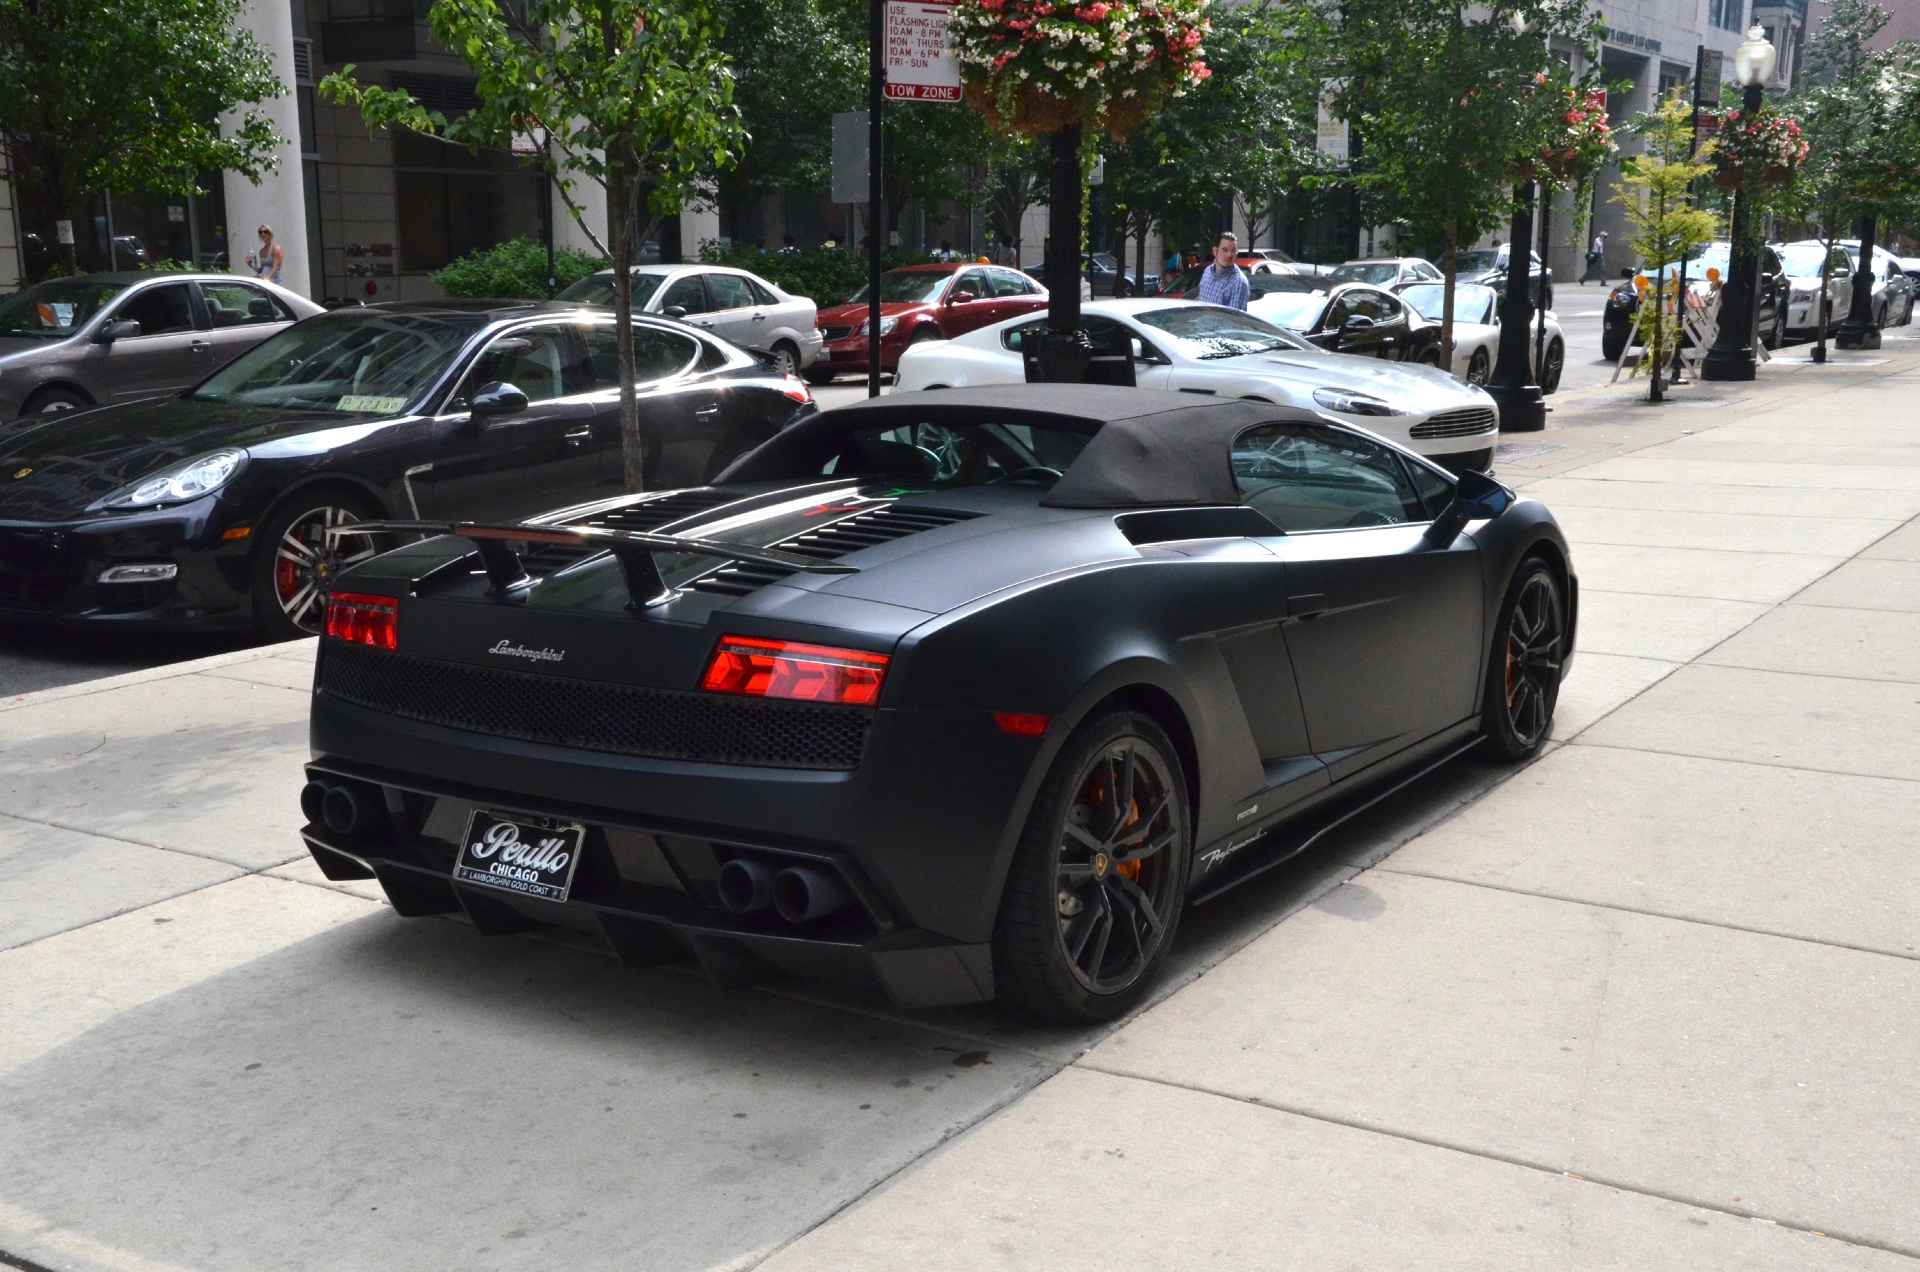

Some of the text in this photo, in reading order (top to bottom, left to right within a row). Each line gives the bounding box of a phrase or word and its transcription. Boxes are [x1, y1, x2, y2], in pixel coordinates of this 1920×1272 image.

[890, 6, 906, 15] USE
[889, 16, 929, 28] FLASHING
[889, 26, 899, 36] 10
[900, 28, 913, 36] AM
[920, 29, 926, 37] 8
[928, 29, 941, 38] PM
[889, 37, 908, 46] MON
[917, 39, 945, 49] THURS
[889, 47, 898, 56] 10
[899, 48, 912, 57] AM
[920, 49, 926, 58] 6
[927, 50, 940, 59] PM
[889, 58, 903, 67] FRI
[911, 59, 928, 68] SUN
[889, 84, 954, 99] TOW ZONE
[488, 639, 566, 662] Lamborghini
[470, 822, 570, 874] Perillo
[489, 862, 539, 882] CHICAGO
[469, 871, 550, 896] LAMBORGHINI GOLD COAST
